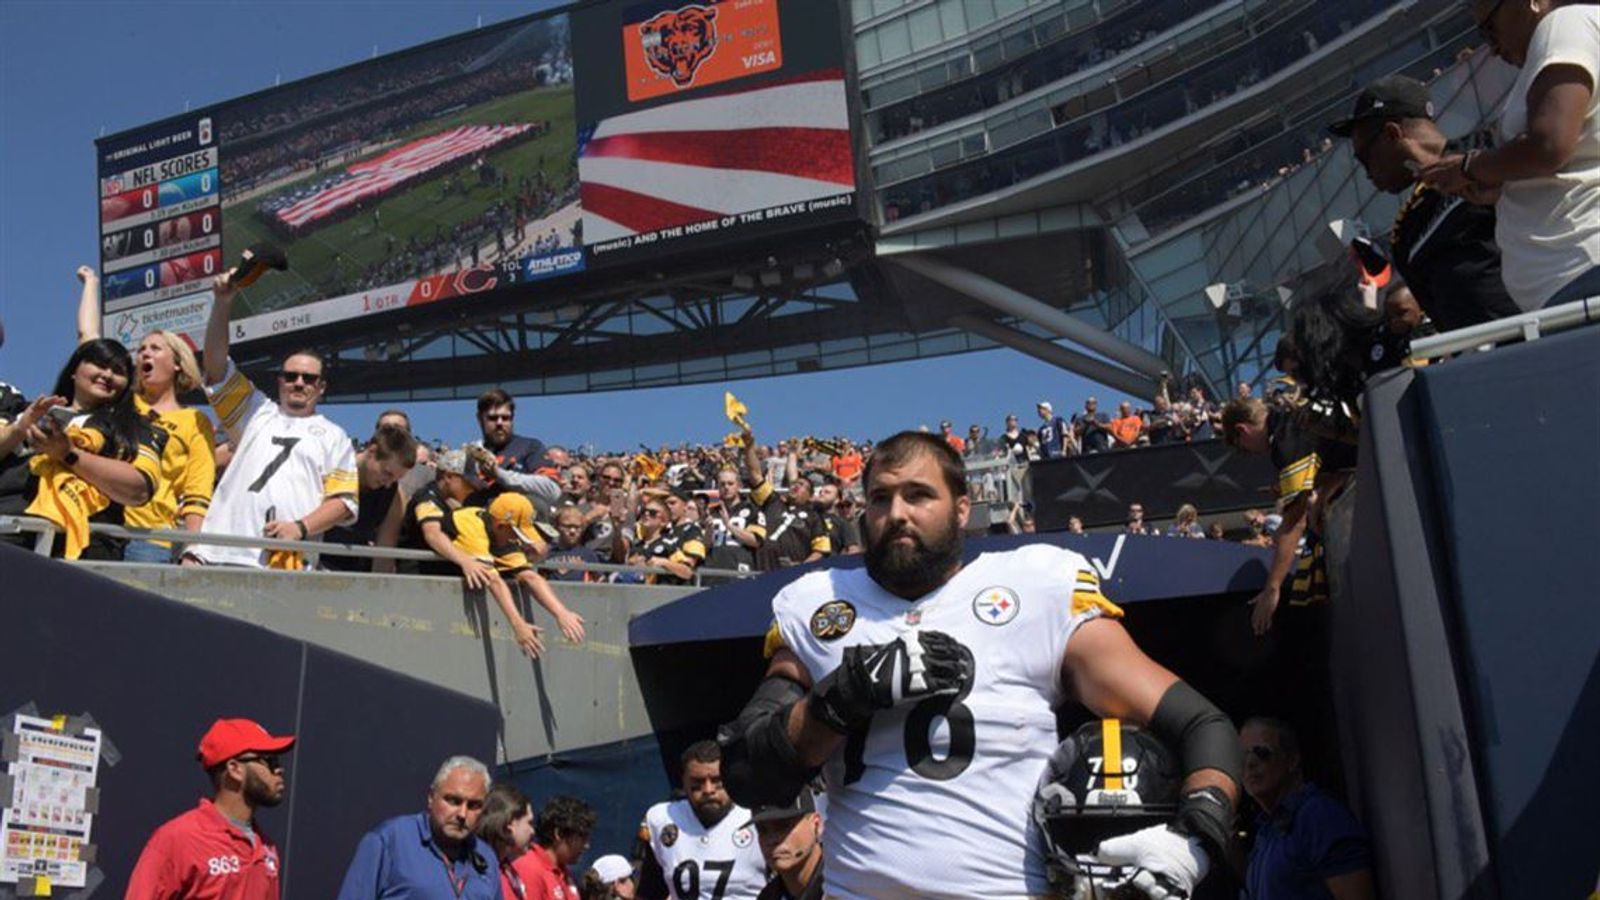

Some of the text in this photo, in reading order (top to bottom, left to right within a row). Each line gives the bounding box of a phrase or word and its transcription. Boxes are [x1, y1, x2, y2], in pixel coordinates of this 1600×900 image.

[741, 50, 776, 69] VISA
[148, 137, 171, 150] LIGHT
[132, 166, 157, 187] NFL
[160, 151, 210, 179] SCORES
[202, 174, 211, 192] 0
[143, 190, 152, 209] 0
[203, 213, 212, 233] 0
[593, 195, 852, 255] (music) AND THE HOME OF THE BRAVE (music)
[144, 229, 153, 248] 0
[204, 254, 213, 274] 0
[502, 262, 522, 273] TOL
[528, 251, 581, 270] ATHLETICO
[145, 269, 154, 288] 0
[421, 282, 431, 297] 0
[362, 294, 370, 311] 1
[142, 302, 206, 324] ticketmaster
[272, 313, 311, 331] ON THE
[236, 325, 246, 338] &
[249, 436, 301, 492] 7
[769, 511, 796, 541] 7
[208, 855, 240, 876] 863
